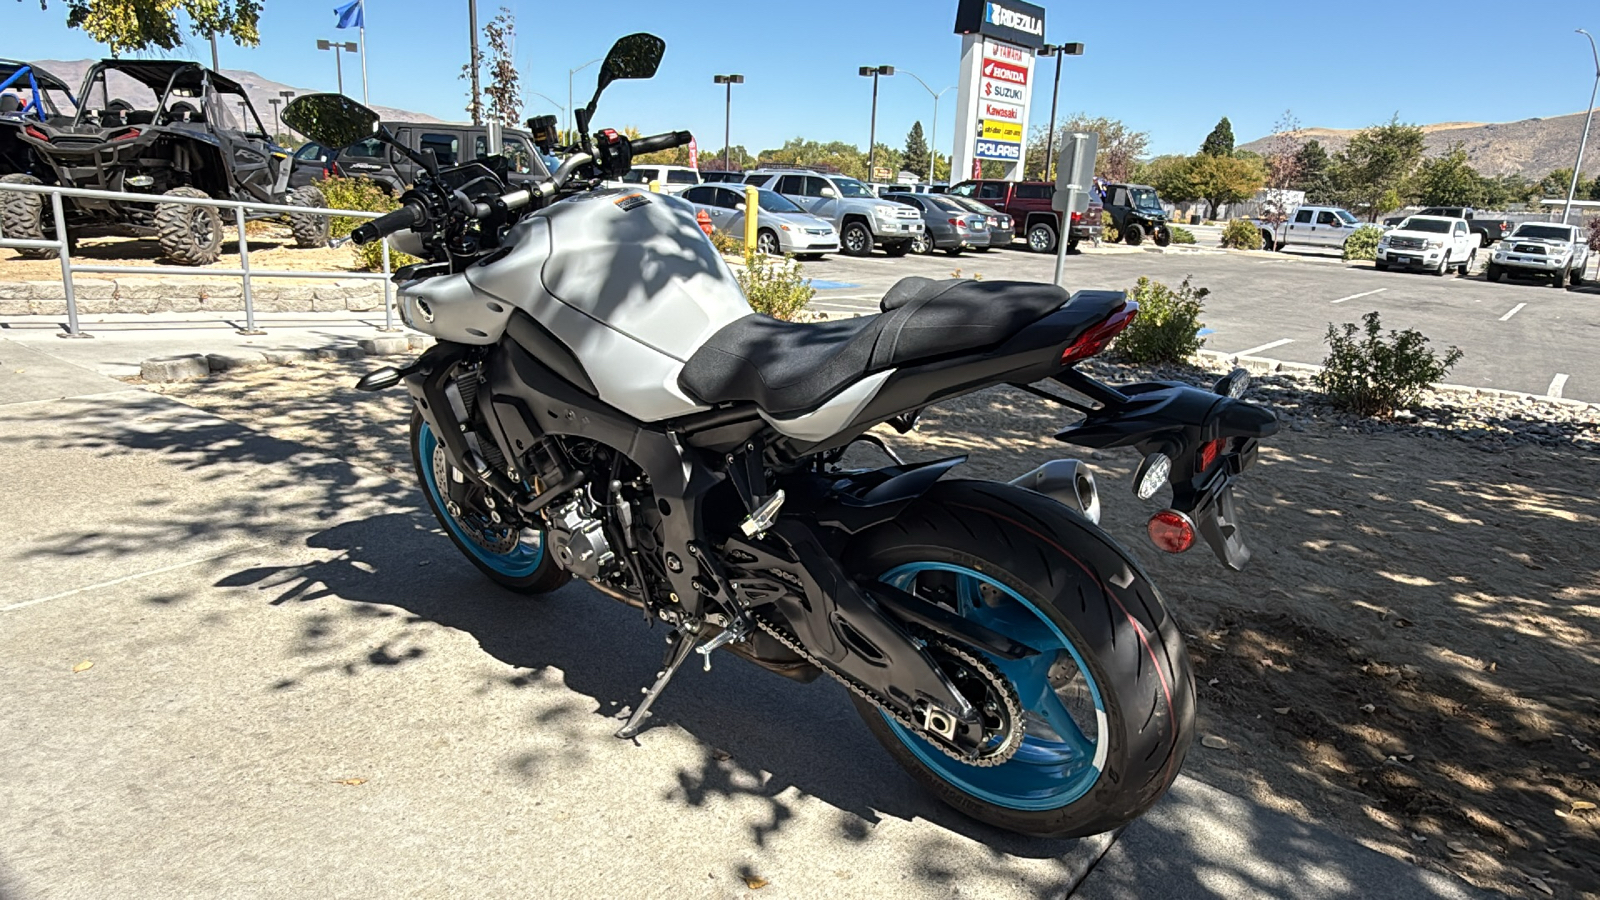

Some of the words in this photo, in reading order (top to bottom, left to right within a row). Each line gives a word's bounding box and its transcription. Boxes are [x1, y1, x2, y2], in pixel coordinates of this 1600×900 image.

[1000, 7, 1042, 37] RIDEZILLA
[999, 45, 1022, 61] YAMAHA
[993, 66, 1025, 83] HONDA
[994, 86, 1022, 100] SUZUKI
[986, 103, 1018, 119] Kawasaki
[976, 142, 1019, 158] POLARIS
